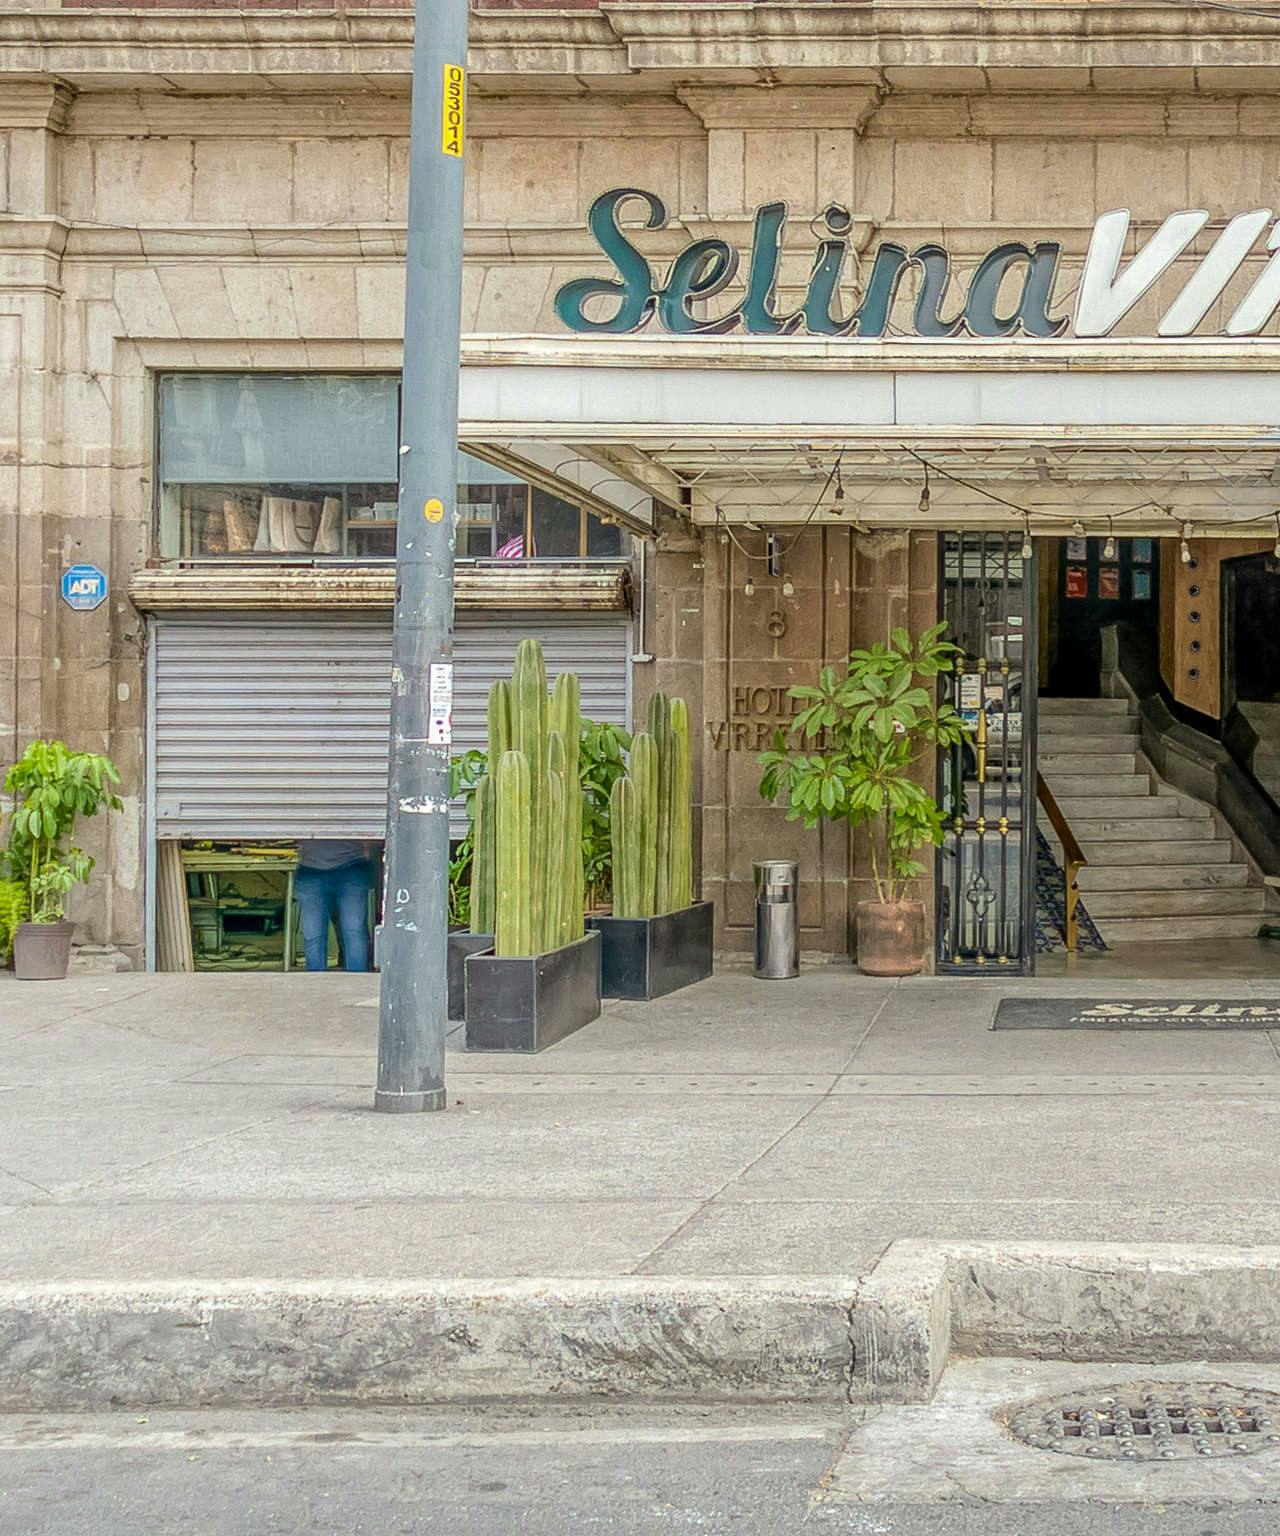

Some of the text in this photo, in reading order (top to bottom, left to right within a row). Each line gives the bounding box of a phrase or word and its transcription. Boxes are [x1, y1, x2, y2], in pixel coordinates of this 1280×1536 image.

[446, 67, 462, 154] 053014
[555, 187, 1069, 337] Selina
[70, 579, 99, 594] ADT
[733, 686, 809, 716] HOT
